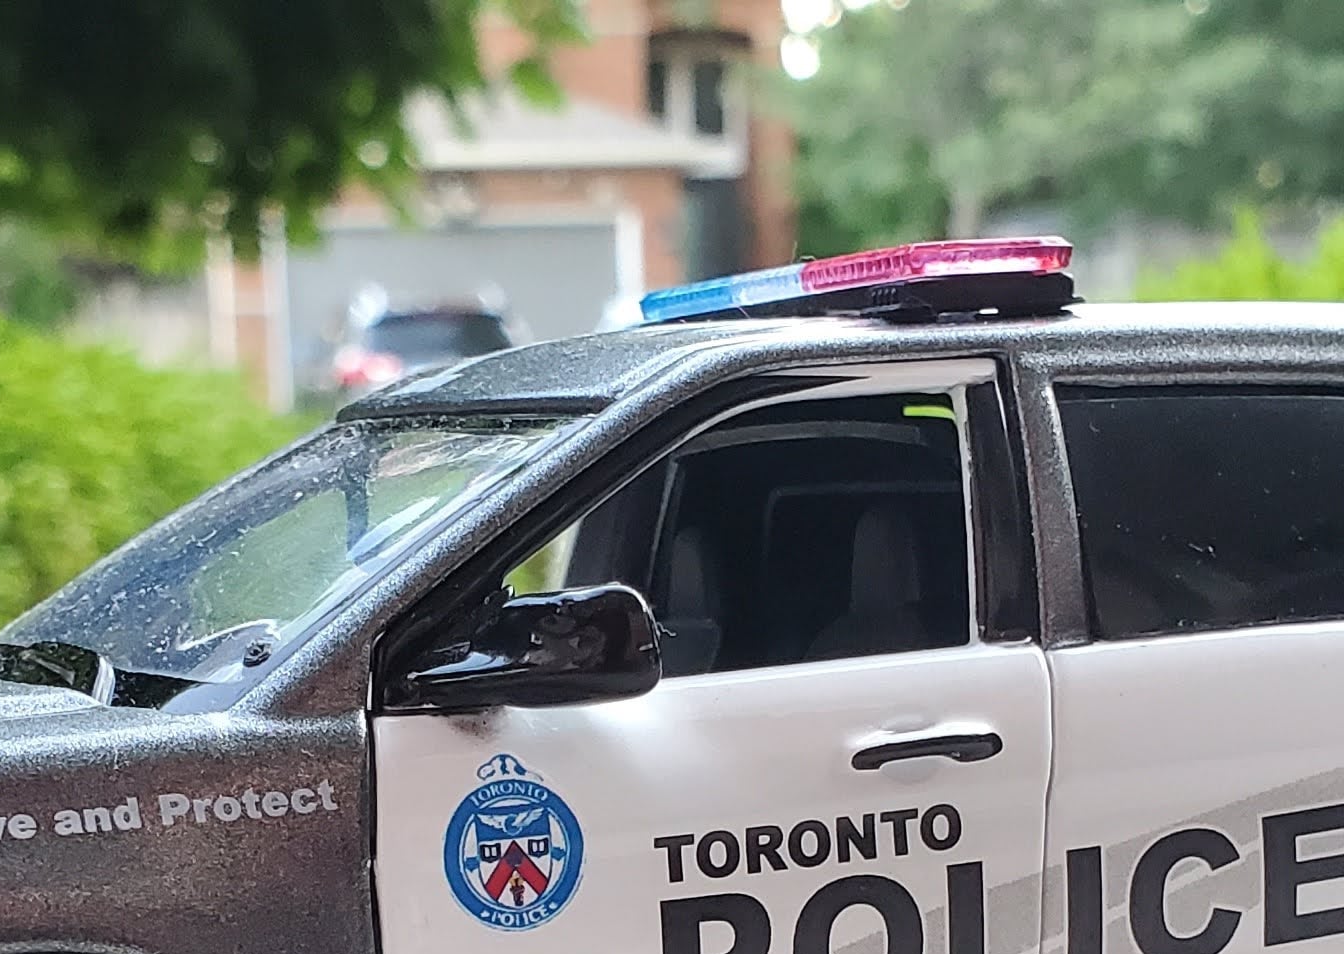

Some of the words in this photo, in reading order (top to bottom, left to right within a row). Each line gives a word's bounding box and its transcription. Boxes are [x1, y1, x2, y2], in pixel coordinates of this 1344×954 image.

[54, 797, 142, 836] and
[156, 778, 339, 826] Protect
[470, 782, 548, 807] TORONTO
[654, 803, 963, 884] TORONTO
[491, 903, 549, 927] POLICE
